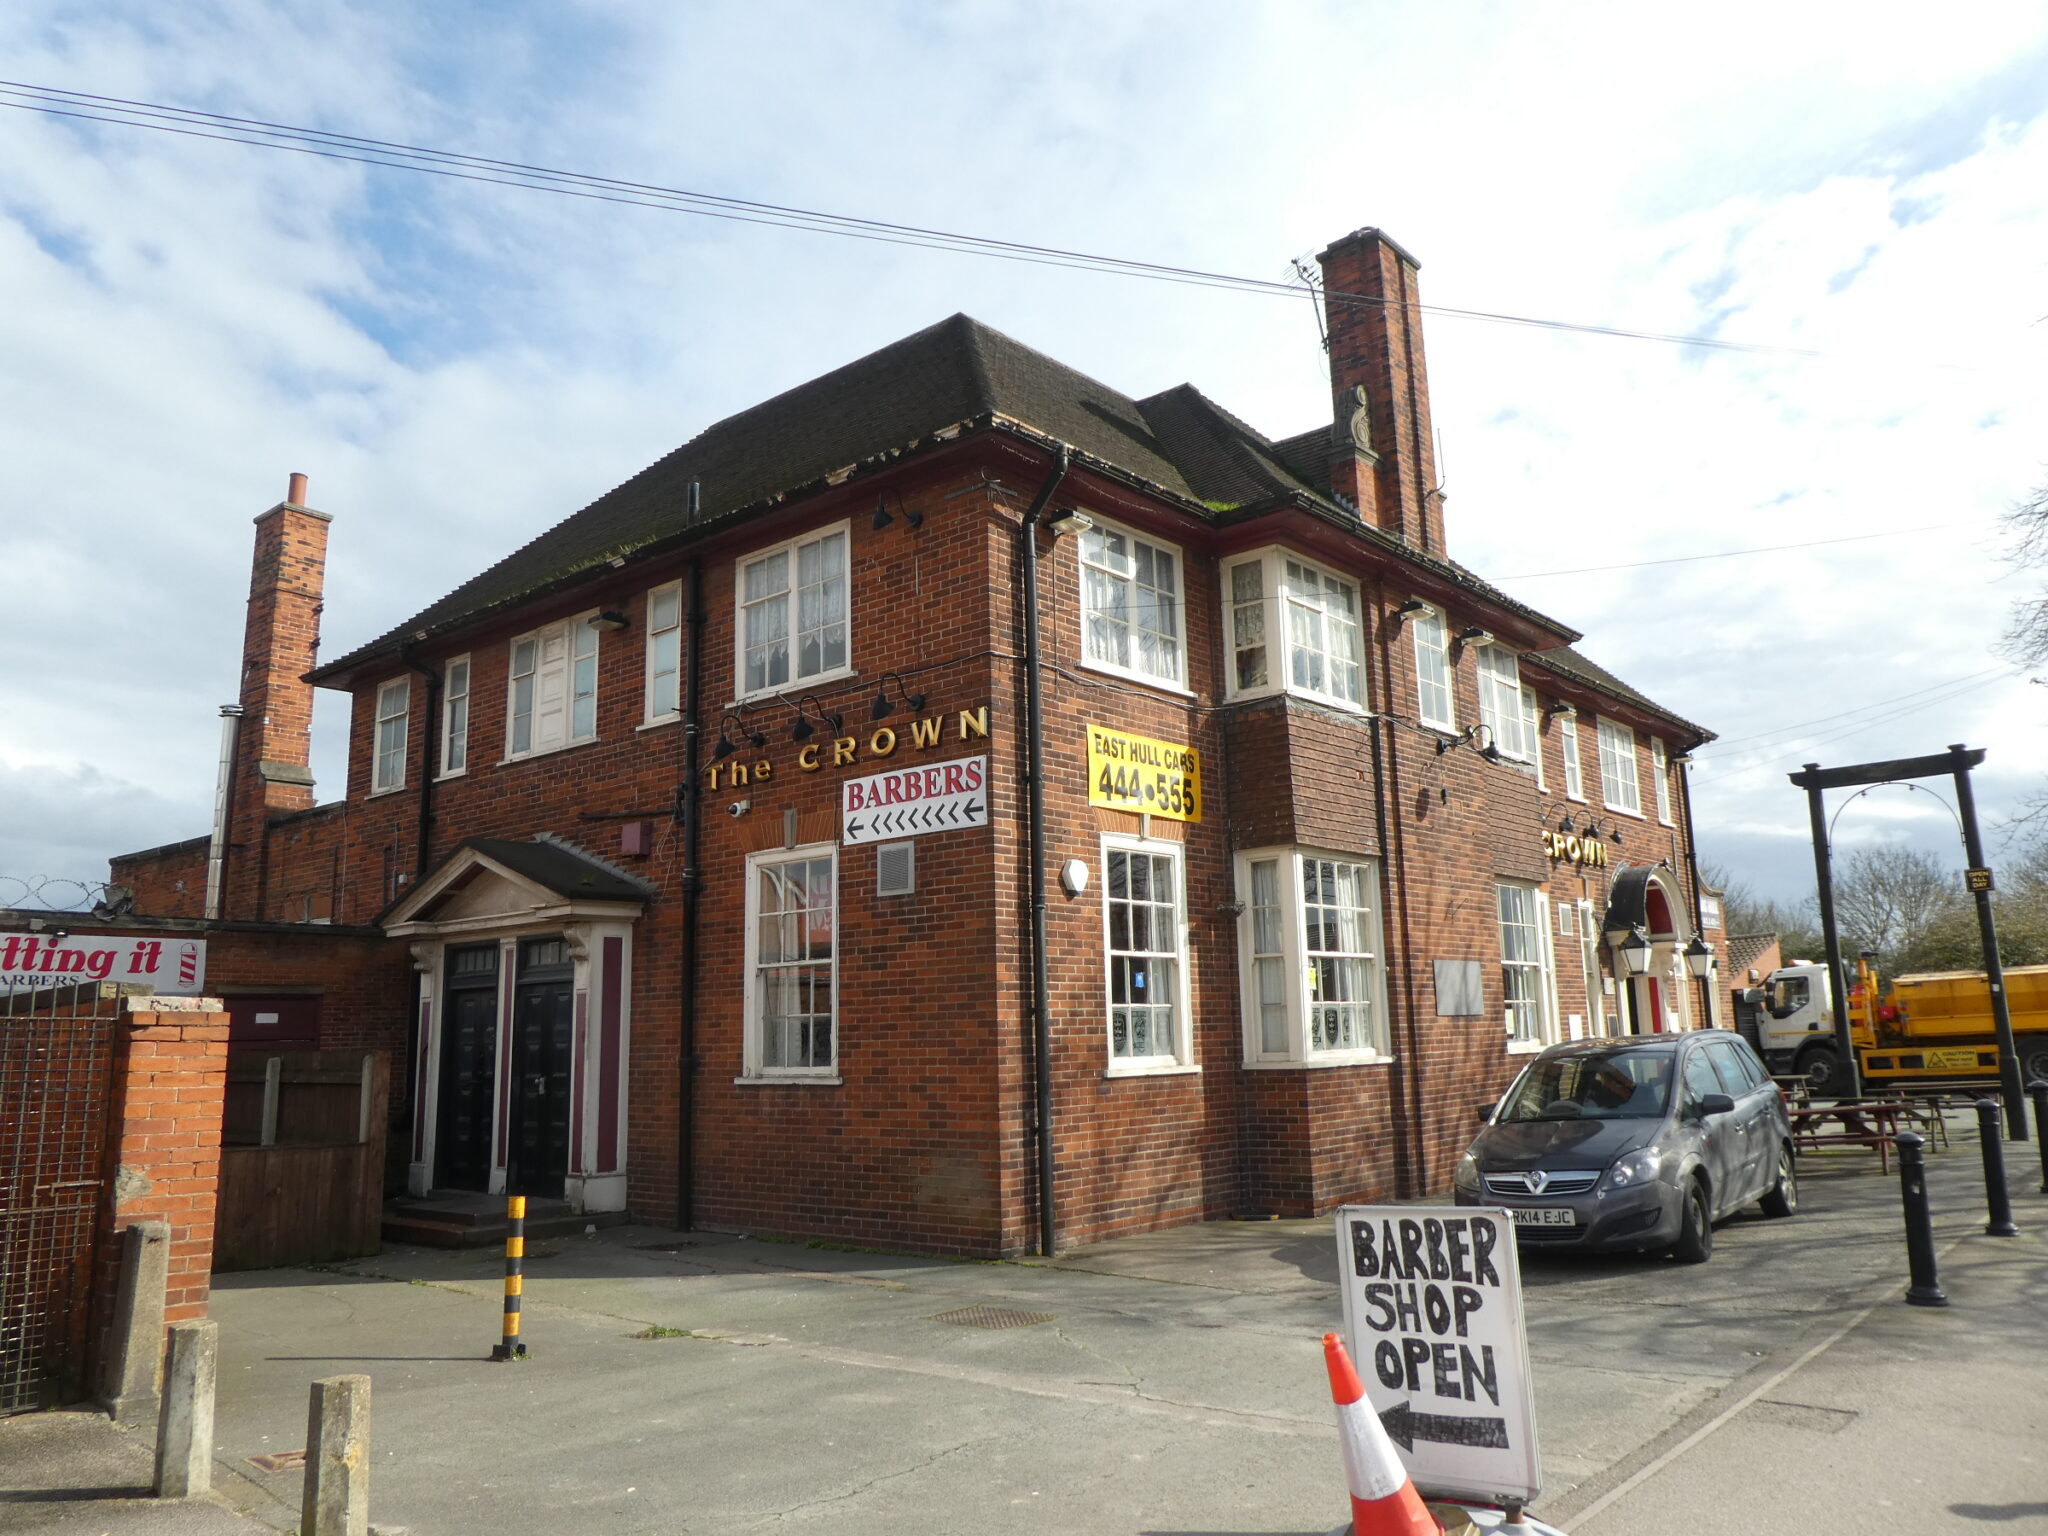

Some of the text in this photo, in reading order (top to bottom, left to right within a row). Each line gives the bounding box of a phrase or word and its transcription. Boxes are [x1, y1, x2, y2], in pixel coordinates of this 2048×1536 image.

[705, 705, 989, 791] The CROWN
[1094, 733, 1195, 774] EAST HULL CARS
[846, 759, 983, 812] BARBERS
[1541, 830, 1609, 866] CROWN
[127, 941, 162, 974] it
[1513, 1211, 1571, 1224] RK14 EJC
[1350, 1216, 1500, 1287] BARBER
[1364, 1283, 1483, 1337] SHOP
[1374, 1337, 1500, 1406] OPEN
